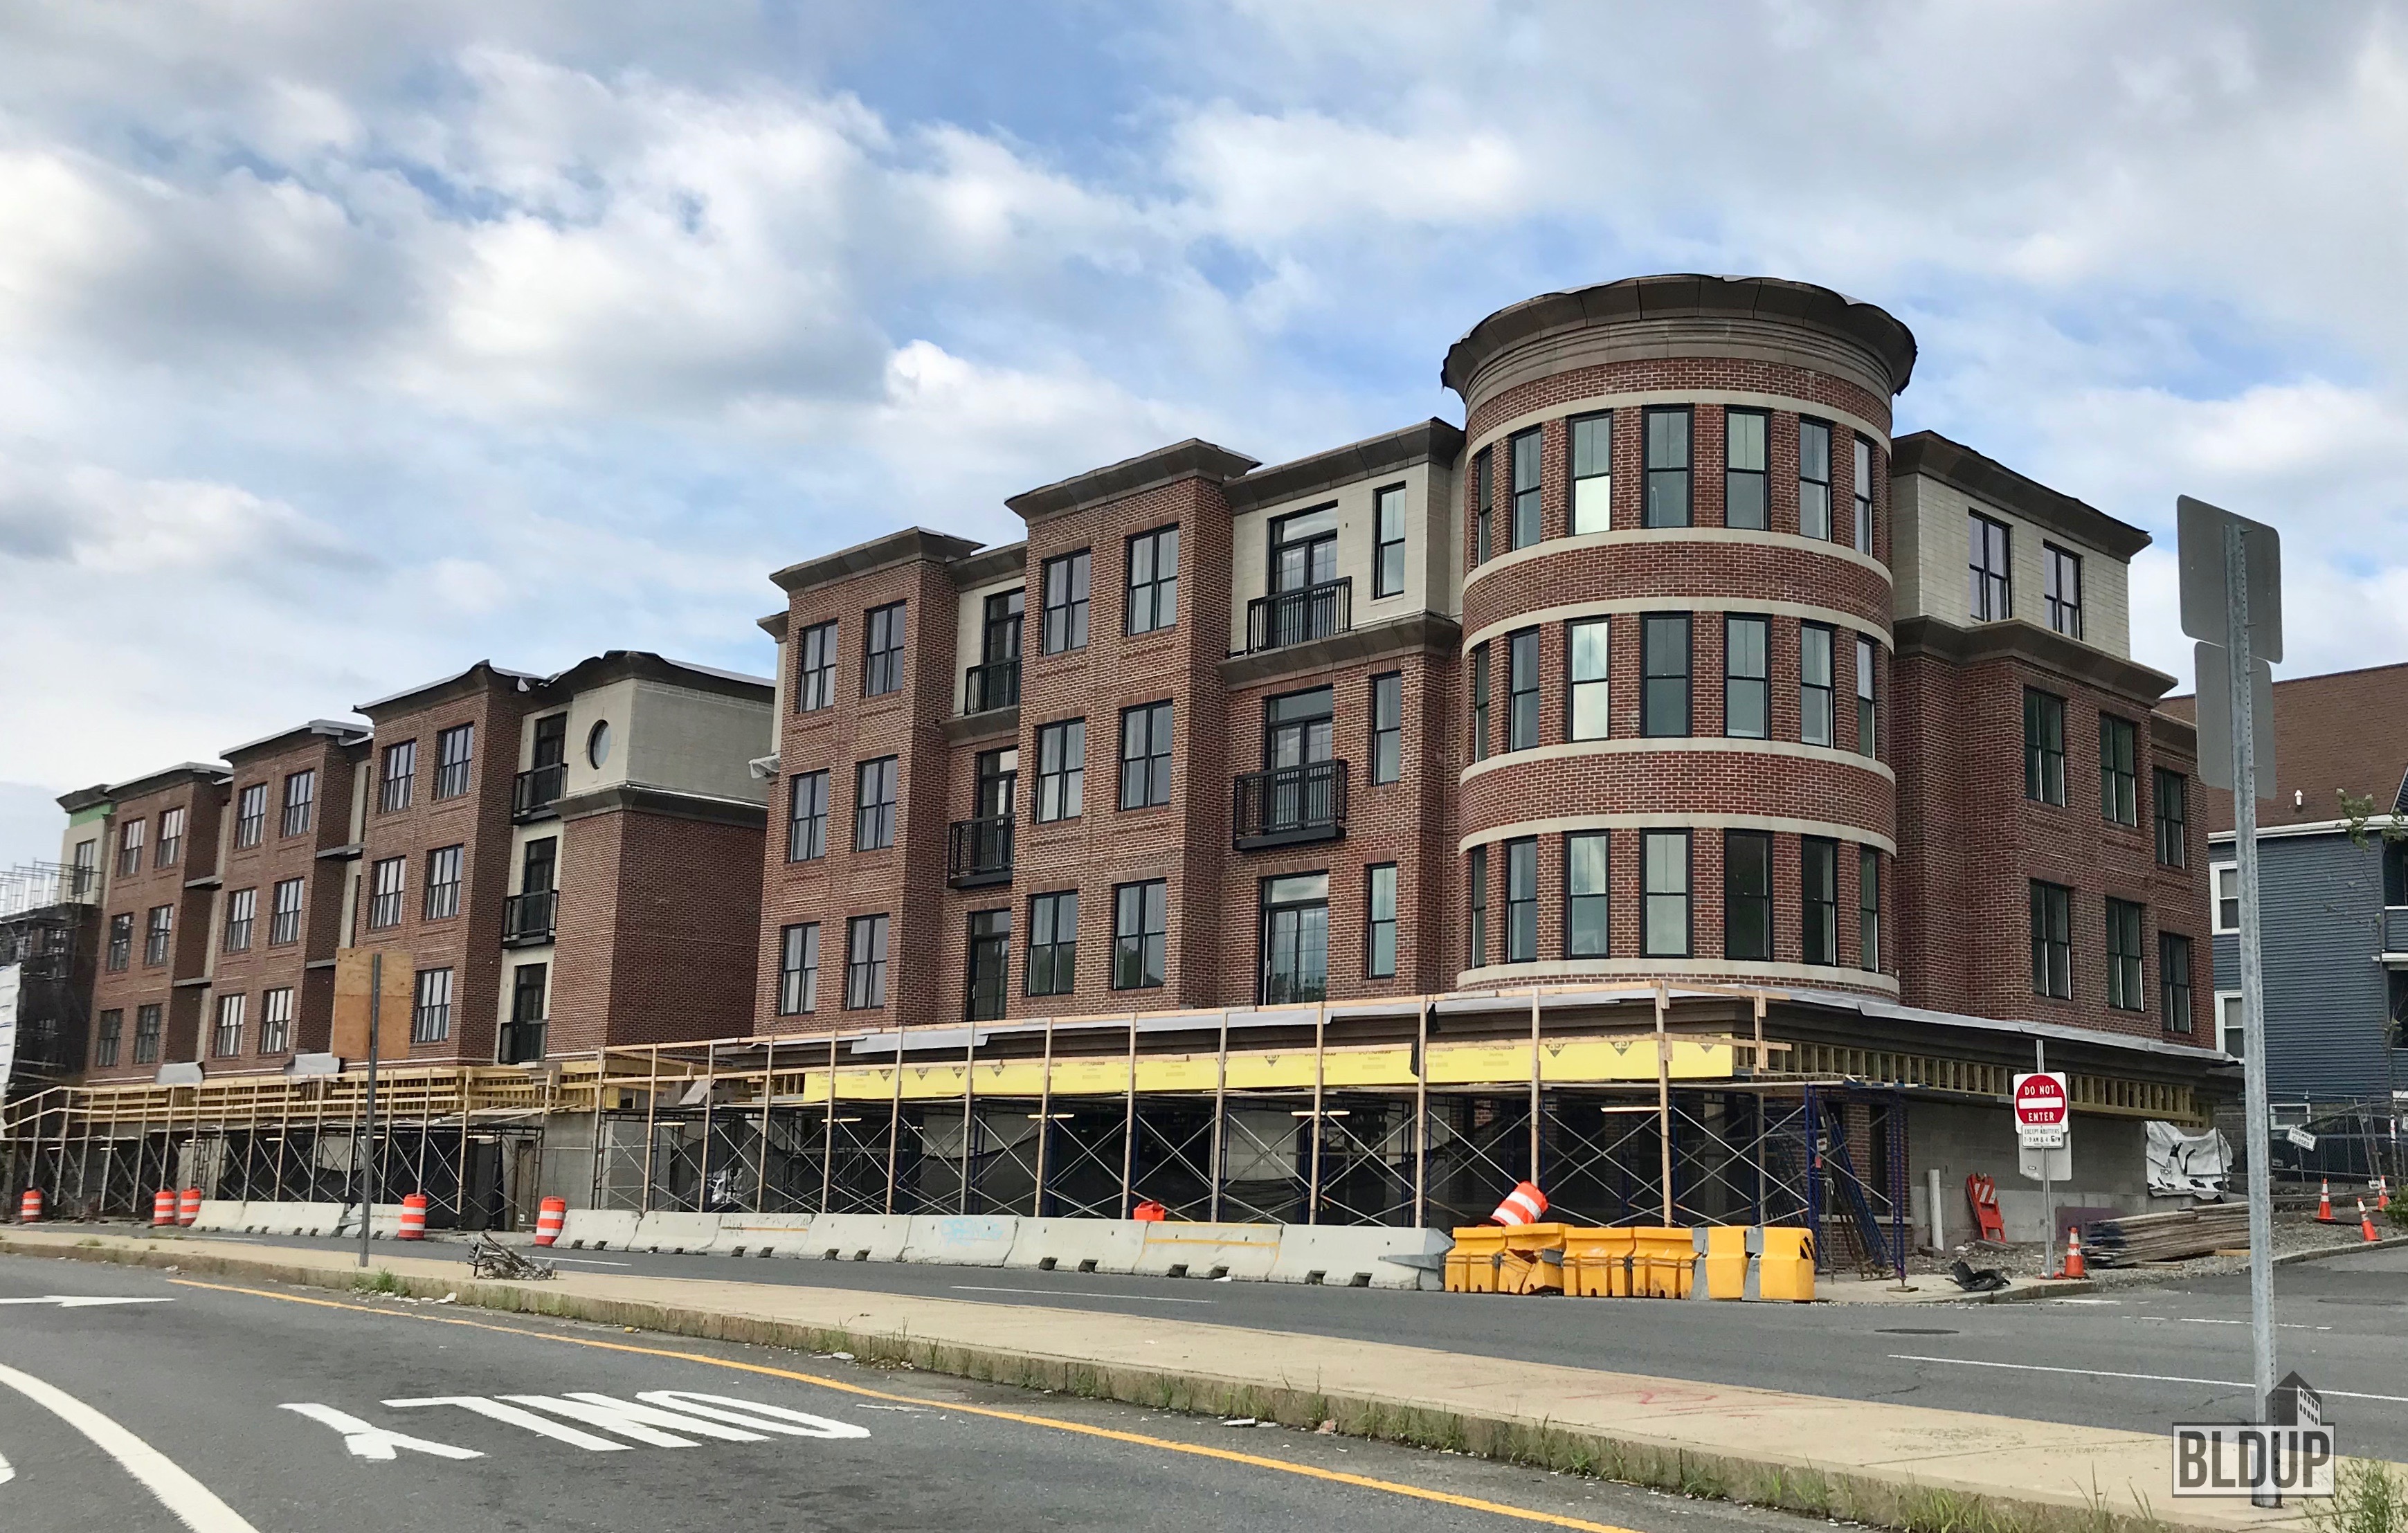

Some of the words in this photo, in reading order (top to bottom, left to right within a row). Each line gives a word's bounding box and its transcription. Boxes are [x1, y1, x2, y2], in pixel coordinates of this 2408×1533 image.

[2025, 1085, 2035, 1096] DO
[2039, 1085, 2055, 1095] NOT
[2028, 1112, 2055, 1122] ENTER
[2292, 1135, 2310, 1147] CLOSED
[277, 1389, 871, 1460] ONLY
